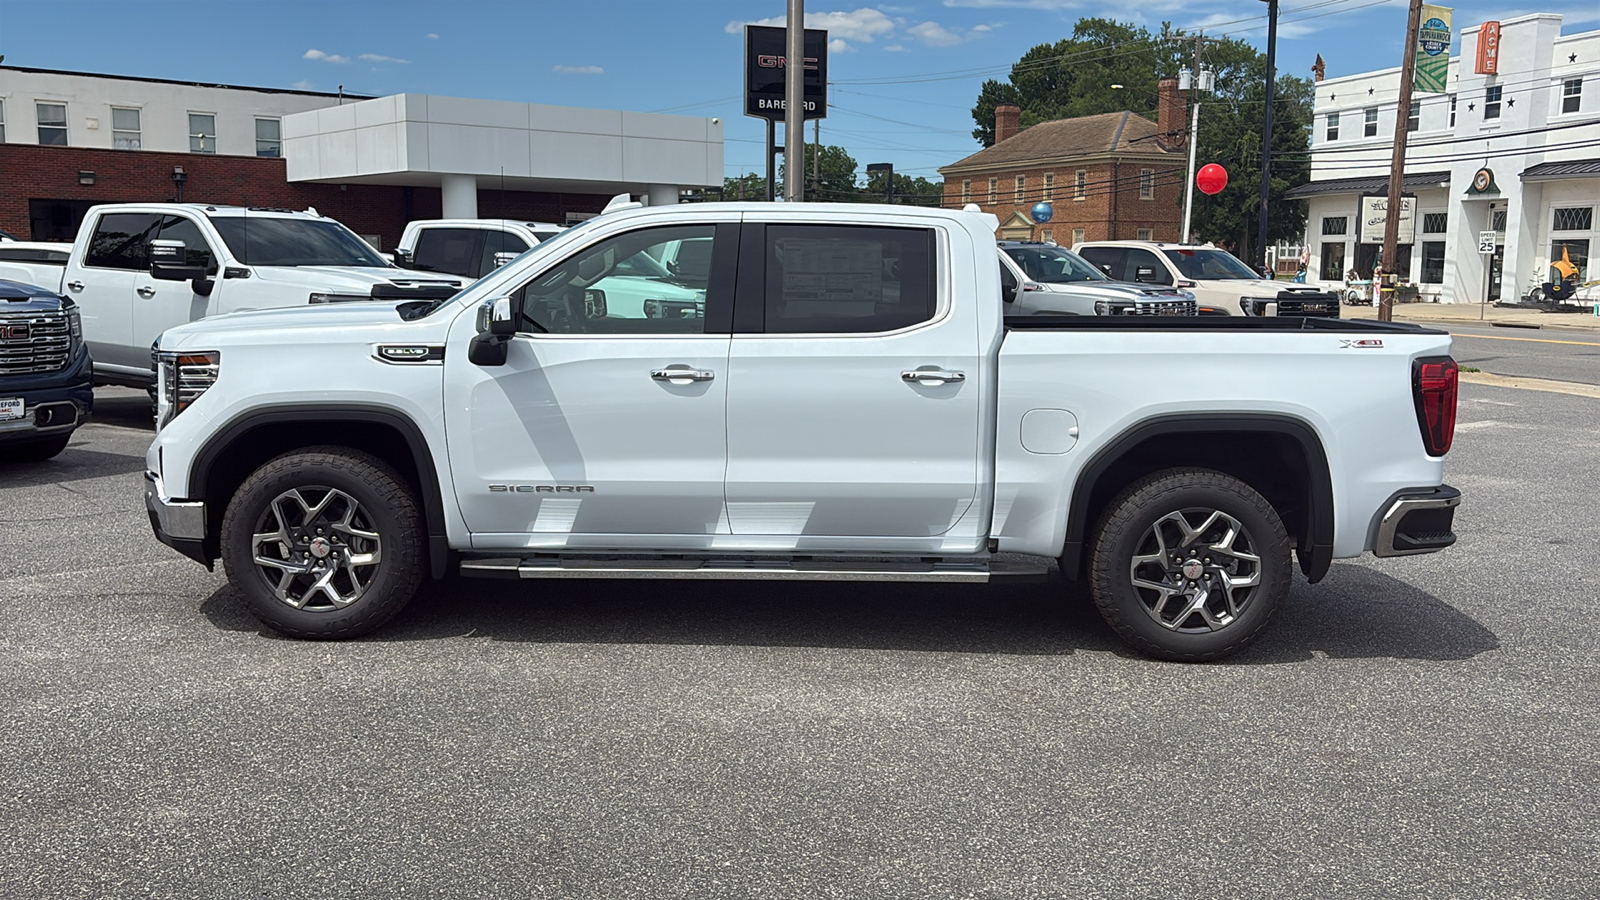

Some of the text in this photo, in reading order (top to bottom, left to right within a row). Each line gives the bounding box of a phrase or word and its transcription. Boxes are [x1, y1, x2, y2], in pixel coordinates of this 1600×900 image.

[1486, 25, 1496, 70] ACME
[759, 99, 816, 111] BARERD
[1480, 242, 1494, 252] 25
[488, 484, 595, 493] SIERRA
